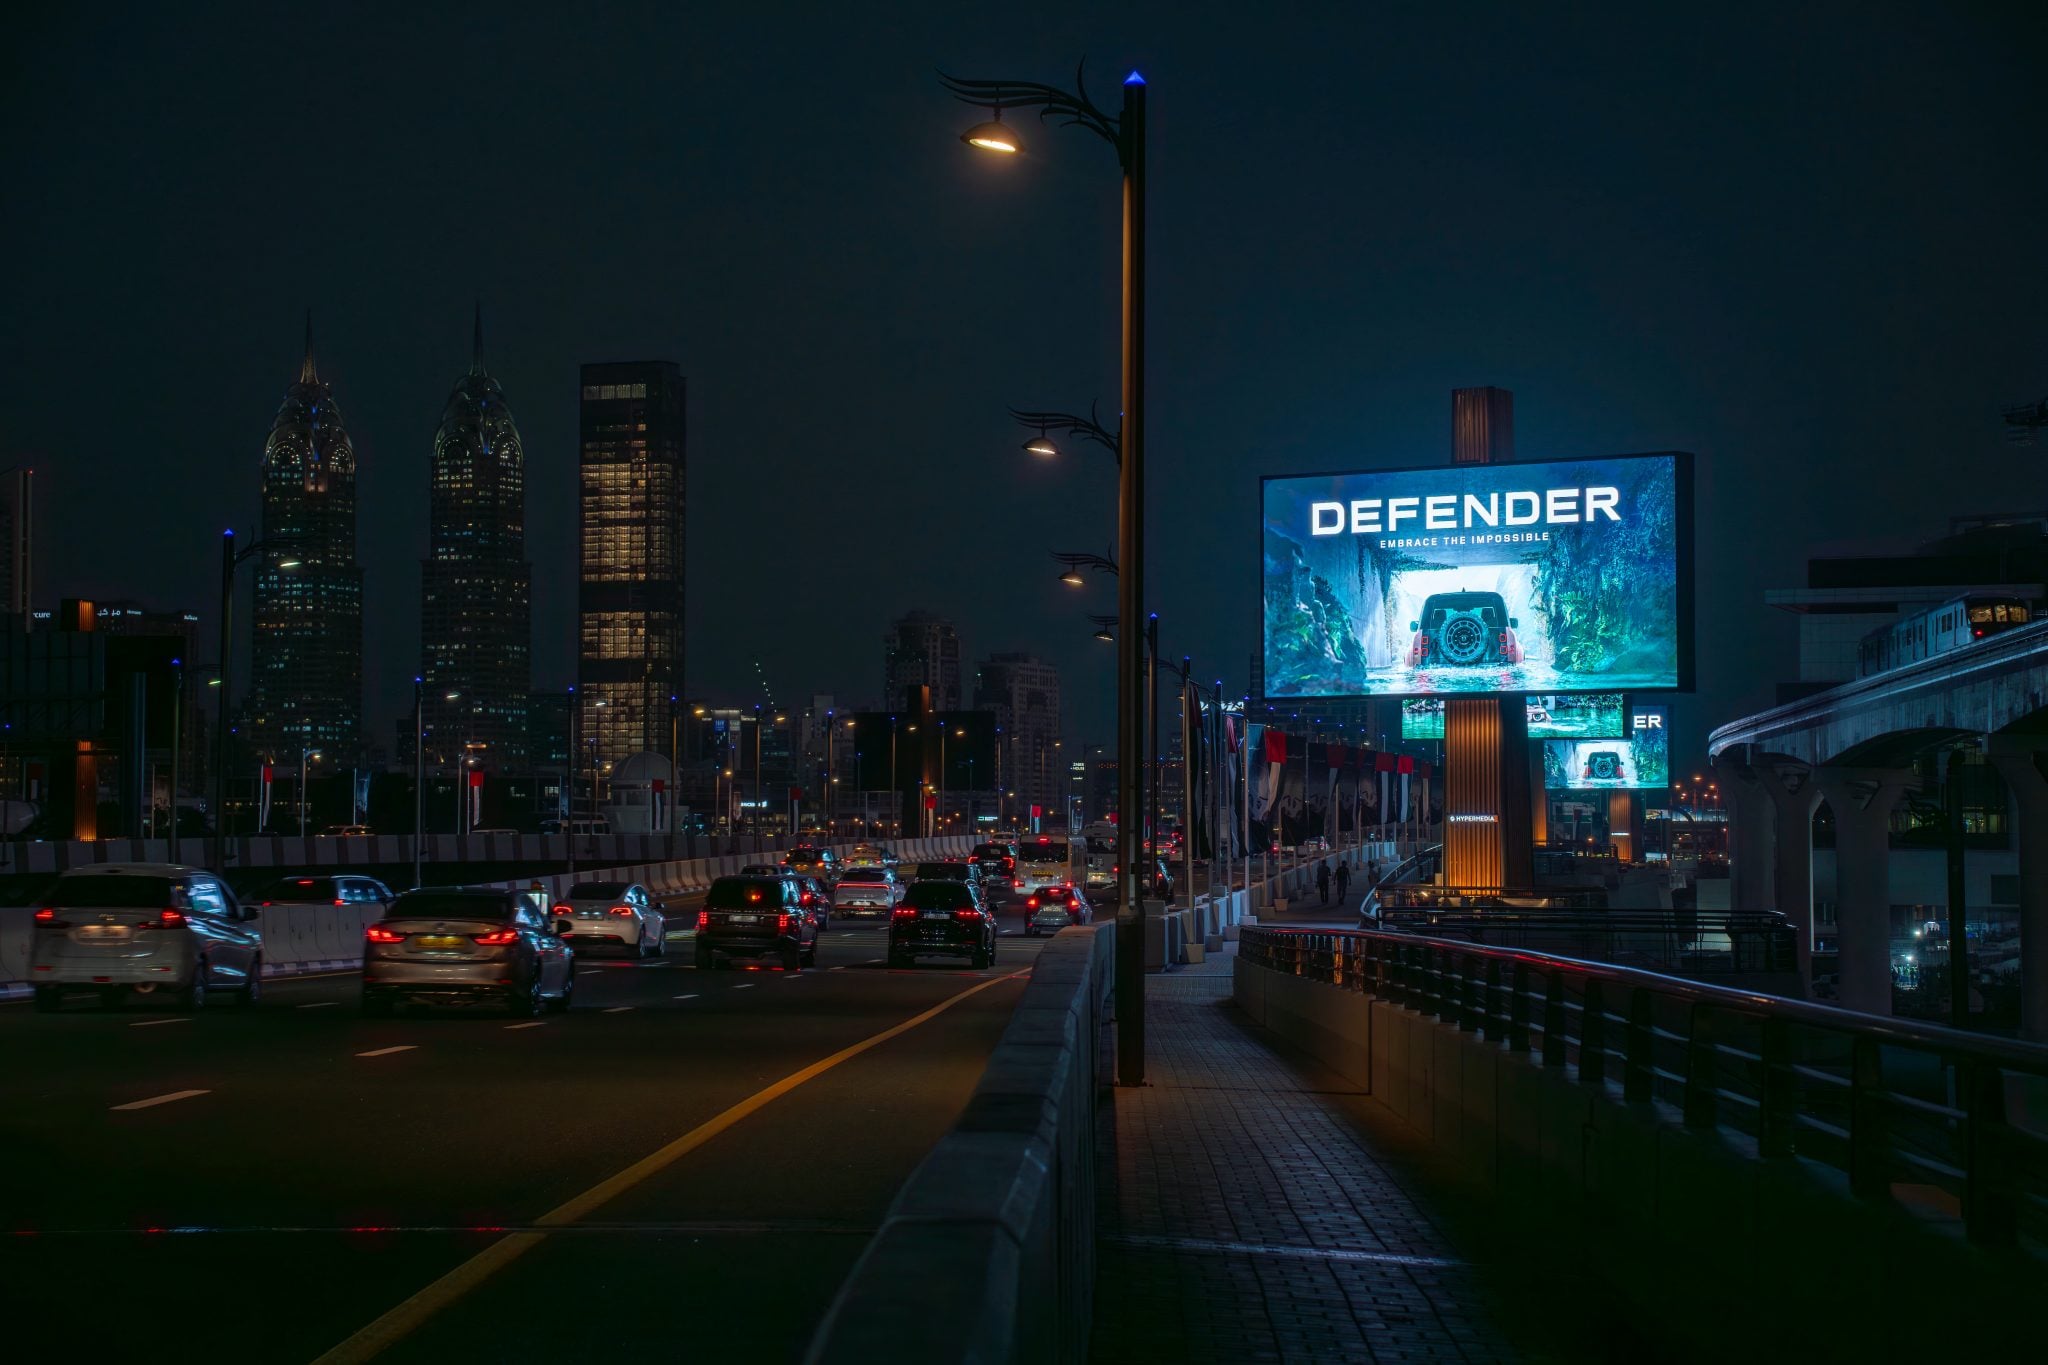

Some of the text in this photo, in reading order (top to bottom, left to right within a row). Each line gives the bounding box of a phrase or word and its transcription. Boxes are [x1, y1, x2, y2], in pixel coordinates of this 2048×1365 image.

[1311, 486, 1621, 536] DEFENDER
[1380, 532, 1550, 549] EMBRACE THE IMPOSSIBLE
[1456, 815, 1495, 823] HYPERMEDIA
